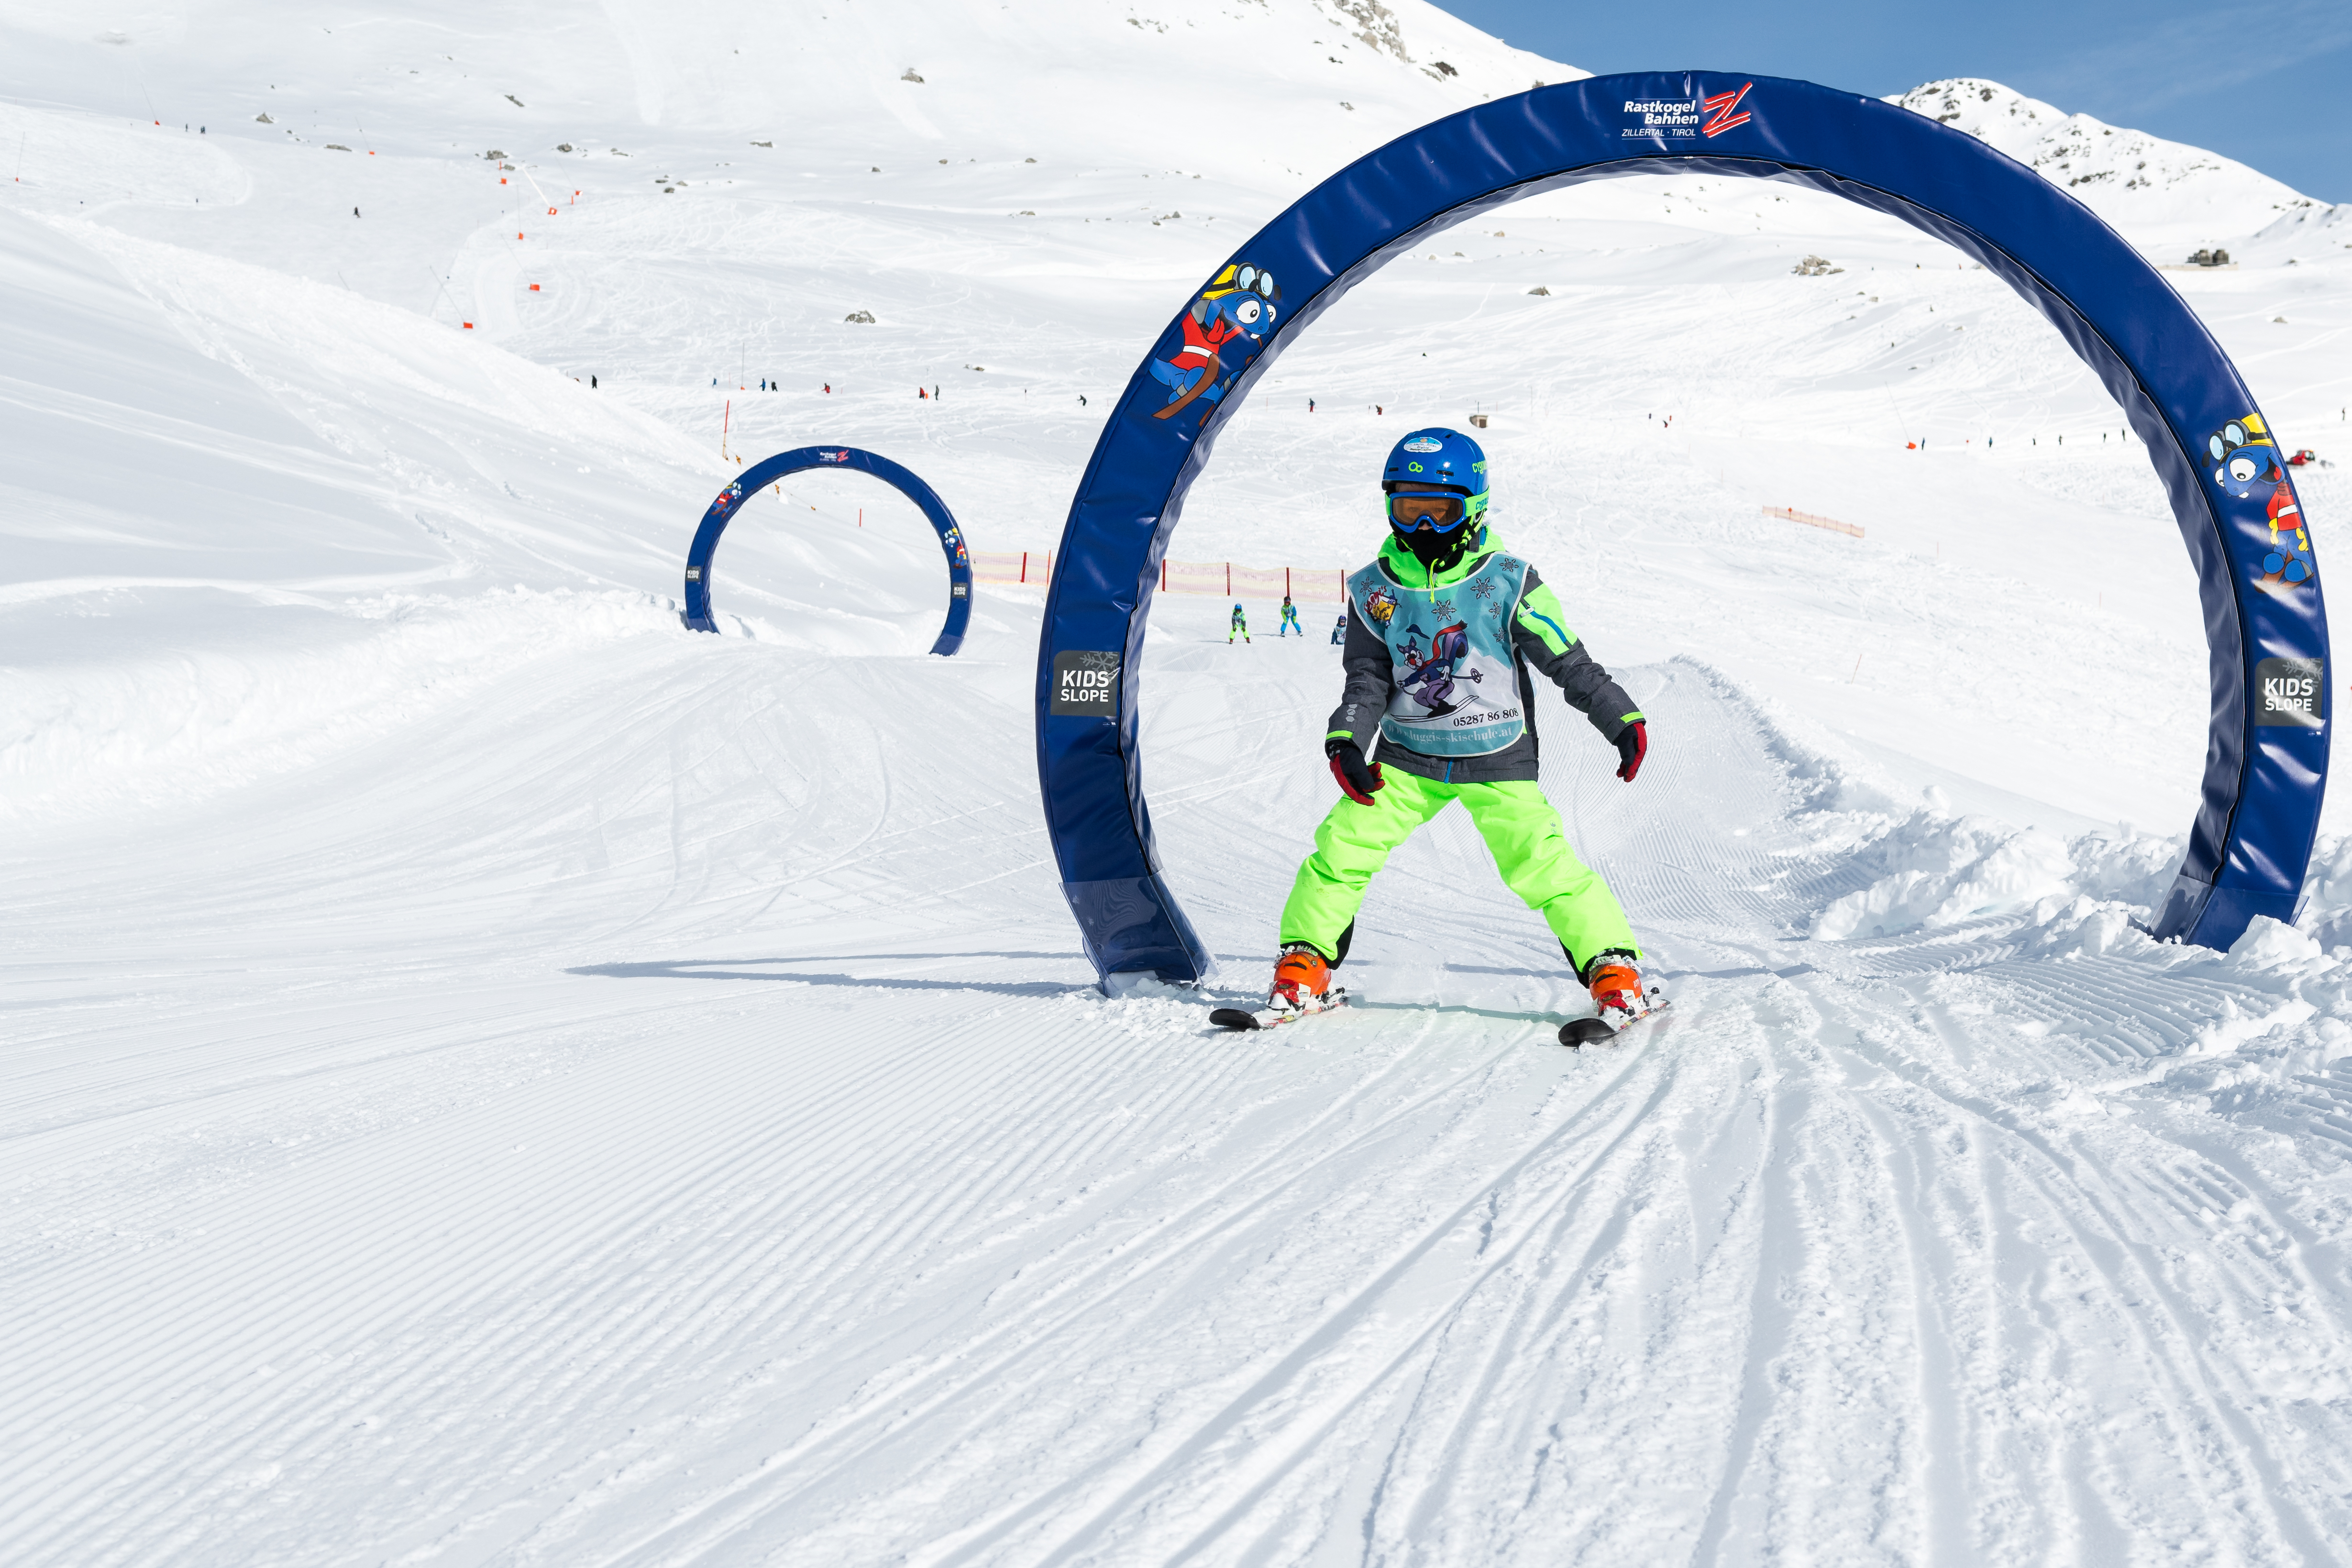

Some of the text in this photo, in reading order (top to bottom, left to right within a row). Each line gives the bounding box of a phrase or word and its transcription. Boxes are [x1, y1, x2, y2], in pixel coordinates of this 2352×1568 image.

[1624, 100, 1696, 115] Rastkogel
[1645, 113, 1699, 124] Bahnen
[1061, 670, 1109, 687] KIDS
[2264, 678, 2313, 696] KIDS
[1060, 689, 1109, 702] SLOPE
[2265, 698, 2313, 711] SLOPE
[1453, 707, 1519, 727] 05287 86 808
[1389, 725, 1513, 744] www.luggis-skischule.at
